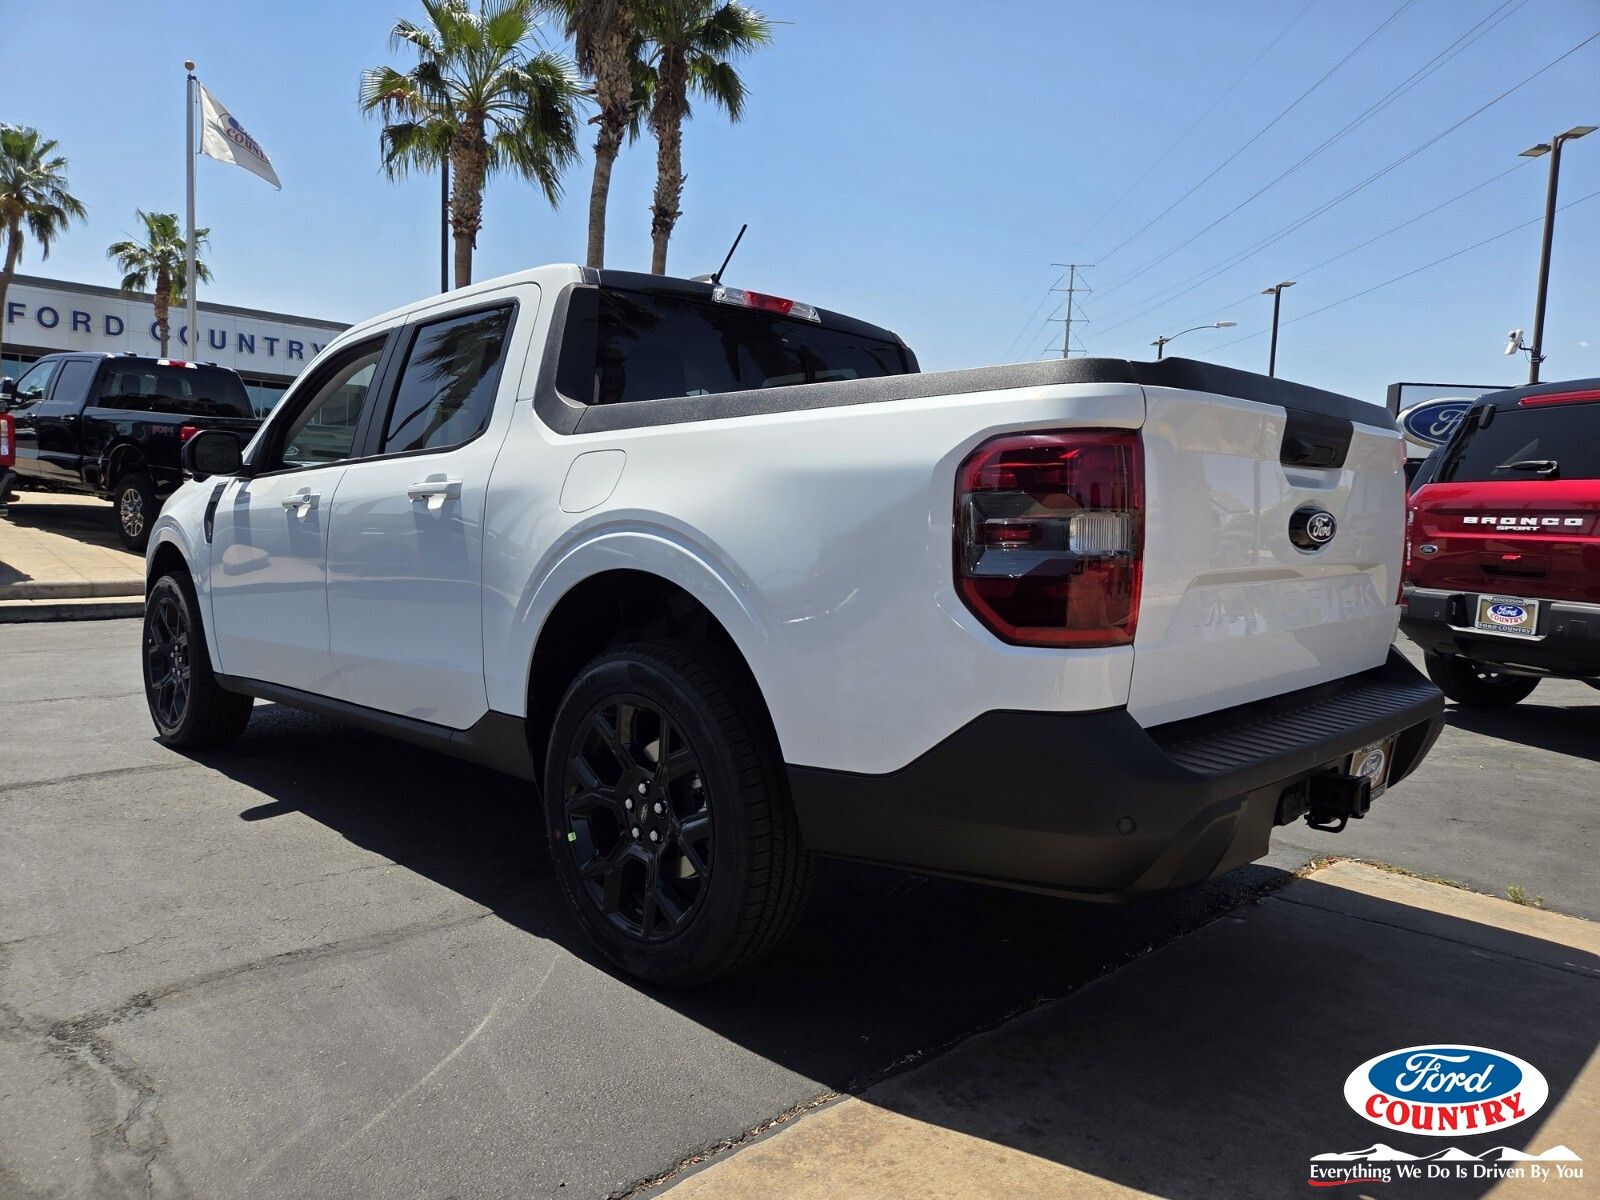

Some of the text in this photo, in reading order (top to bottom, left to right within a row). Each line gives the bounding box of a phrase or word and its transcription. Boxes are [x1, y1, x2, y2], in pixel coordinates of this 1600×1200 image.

[7, 301, 124, 337] FORD
[1463, 516, 1584, 526] BRONCO
[1496, 604, 1518, 616] Ford
[1491, 613, 1523, 624] COUNTRY
